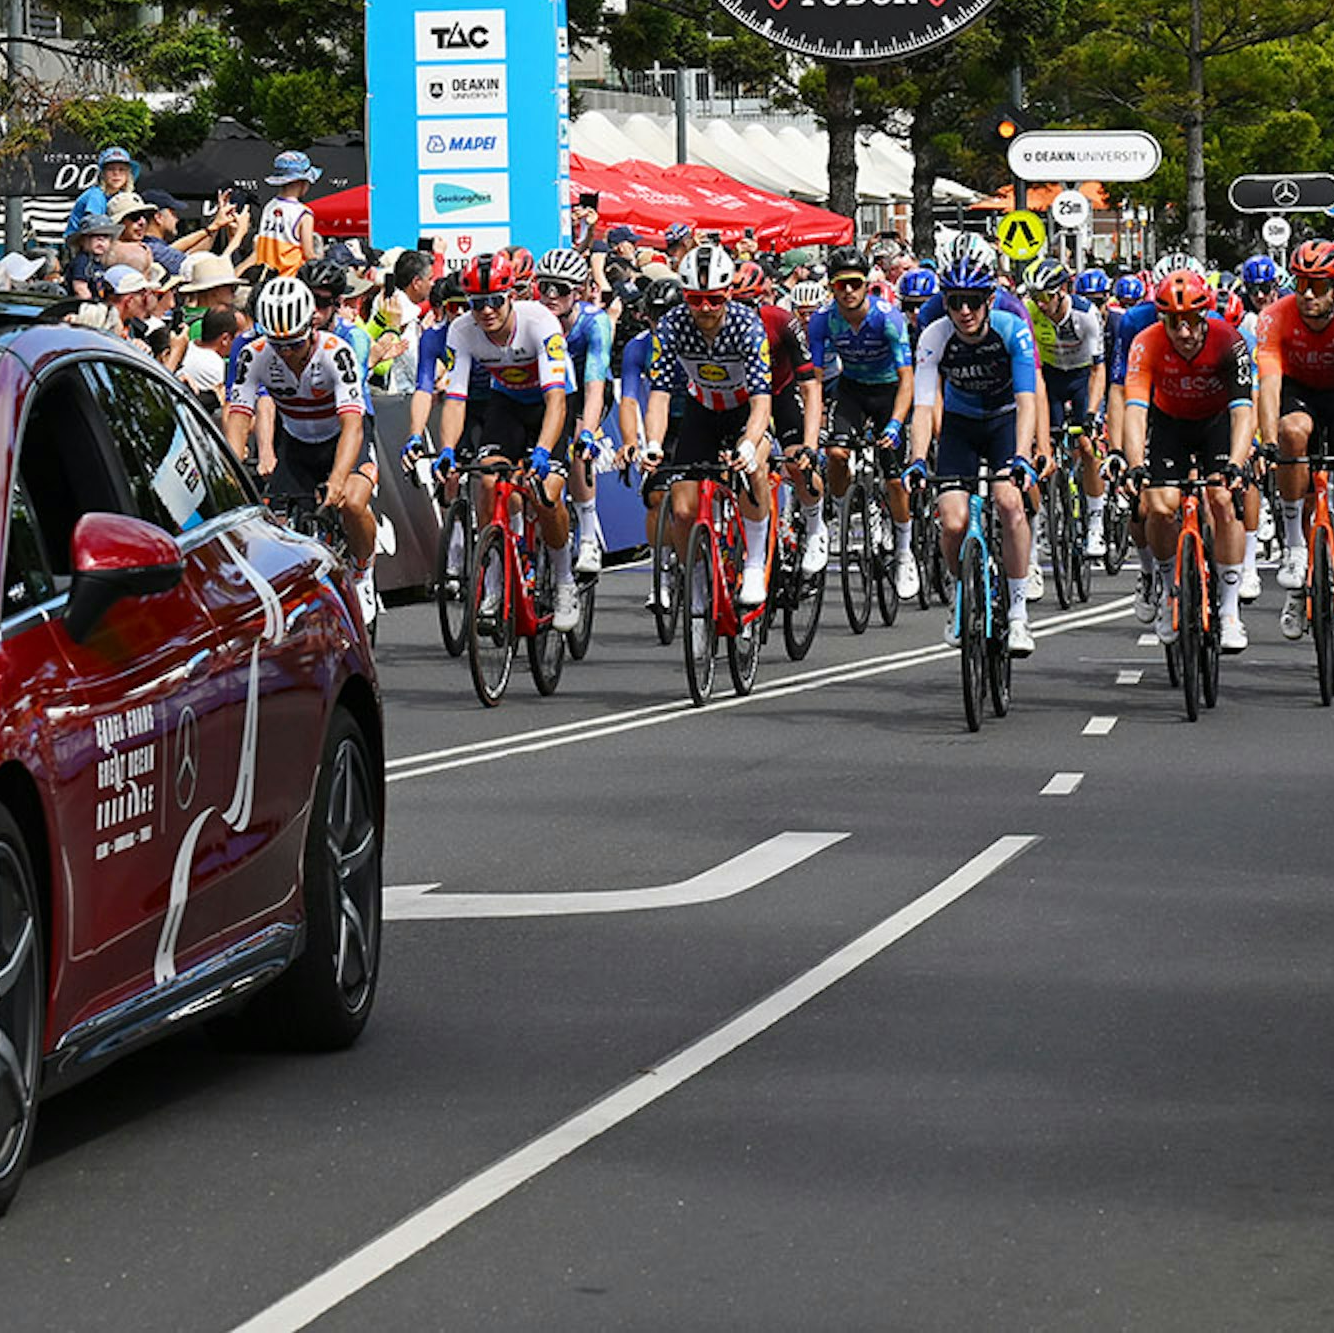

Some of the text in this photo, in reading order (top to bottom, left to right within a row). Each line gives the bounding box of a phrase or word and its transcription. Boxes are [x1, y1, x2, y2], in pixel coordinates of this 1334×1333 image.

[430, 21, 490, 50] TAC
[452, 78, 500, 92] DEAKIN
[448, 136, 496, 151] MAPEI
[1035, 150, 1148, 163] DEAKIN UNIVERSITY
[1232, 339, 1252, 386] INEOS
